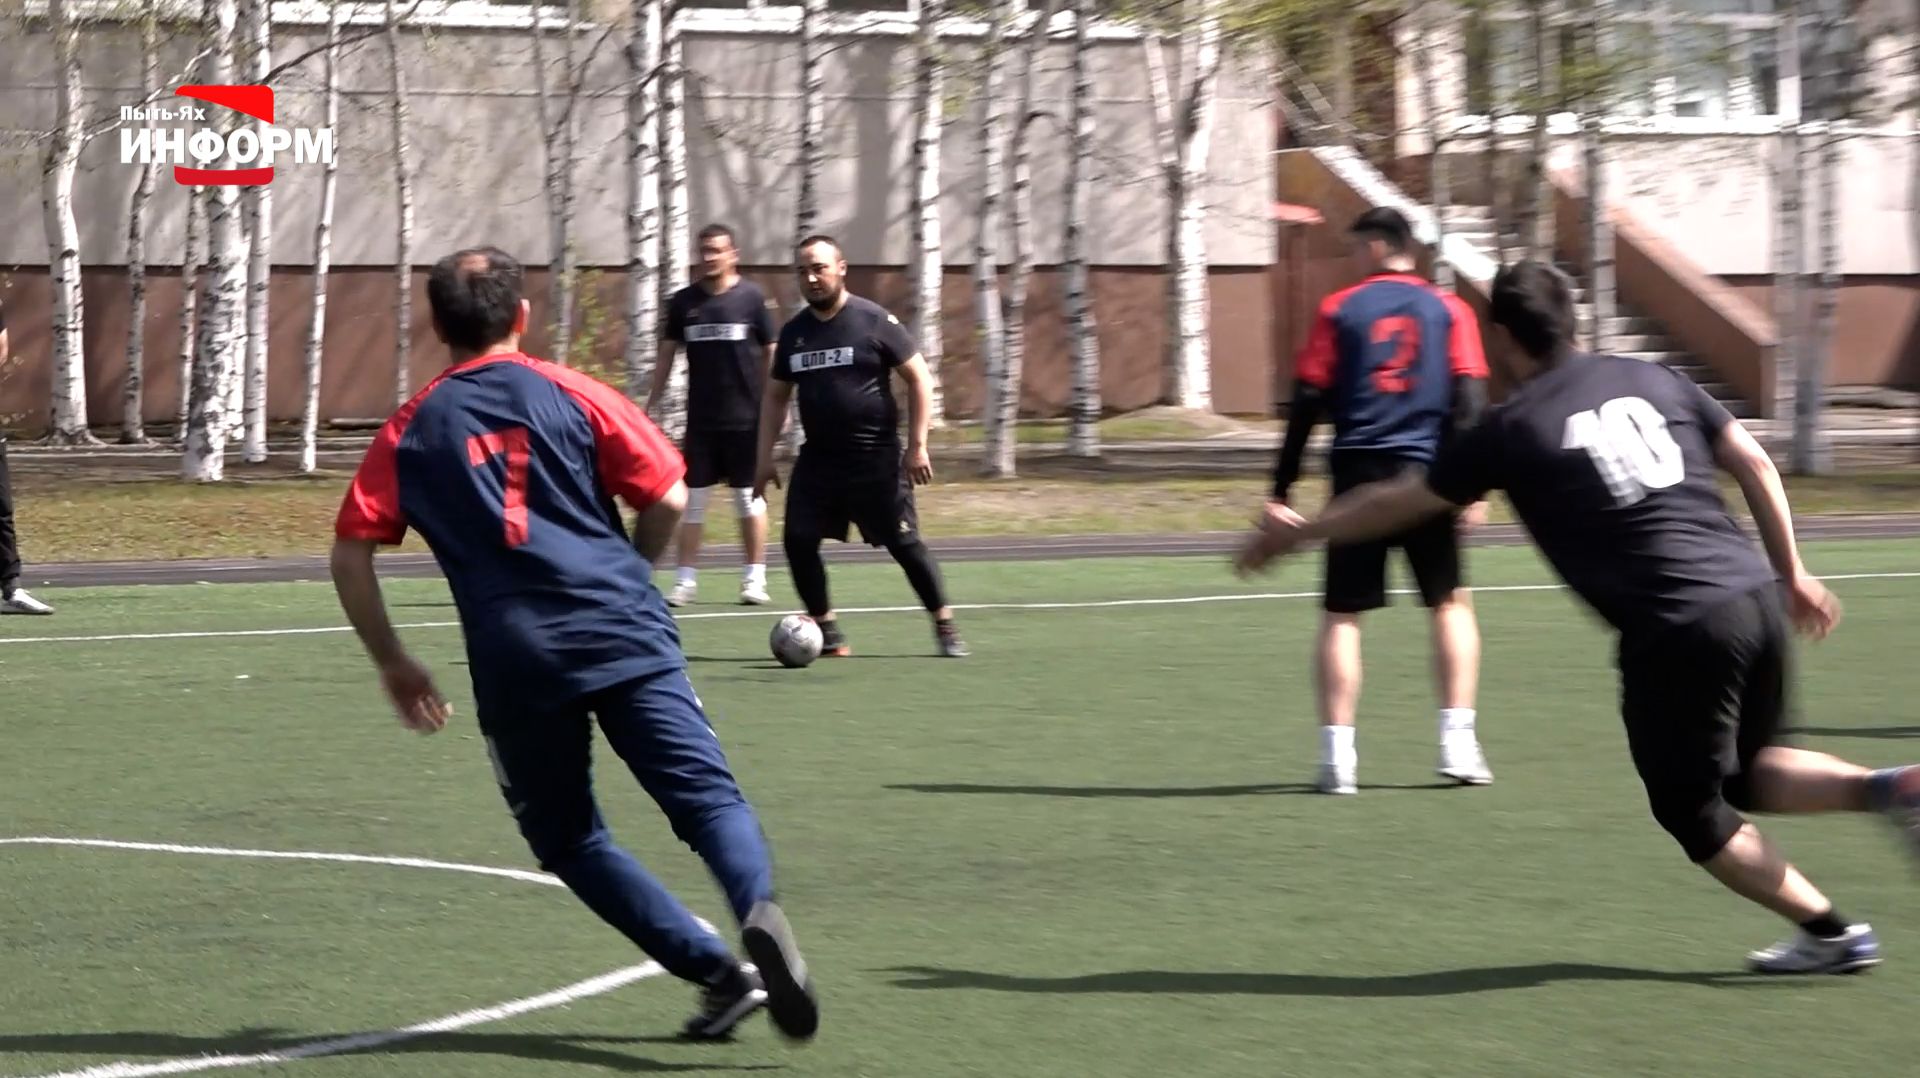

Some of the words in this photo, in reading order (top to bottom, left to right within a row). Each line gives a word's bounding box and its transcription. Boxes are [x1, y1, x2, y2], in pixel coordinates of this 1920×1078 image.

[1370, 316, 1422, 394] 2
[467, 427, 531, 548] 7
[1561, 396, 1685, 507] 10
